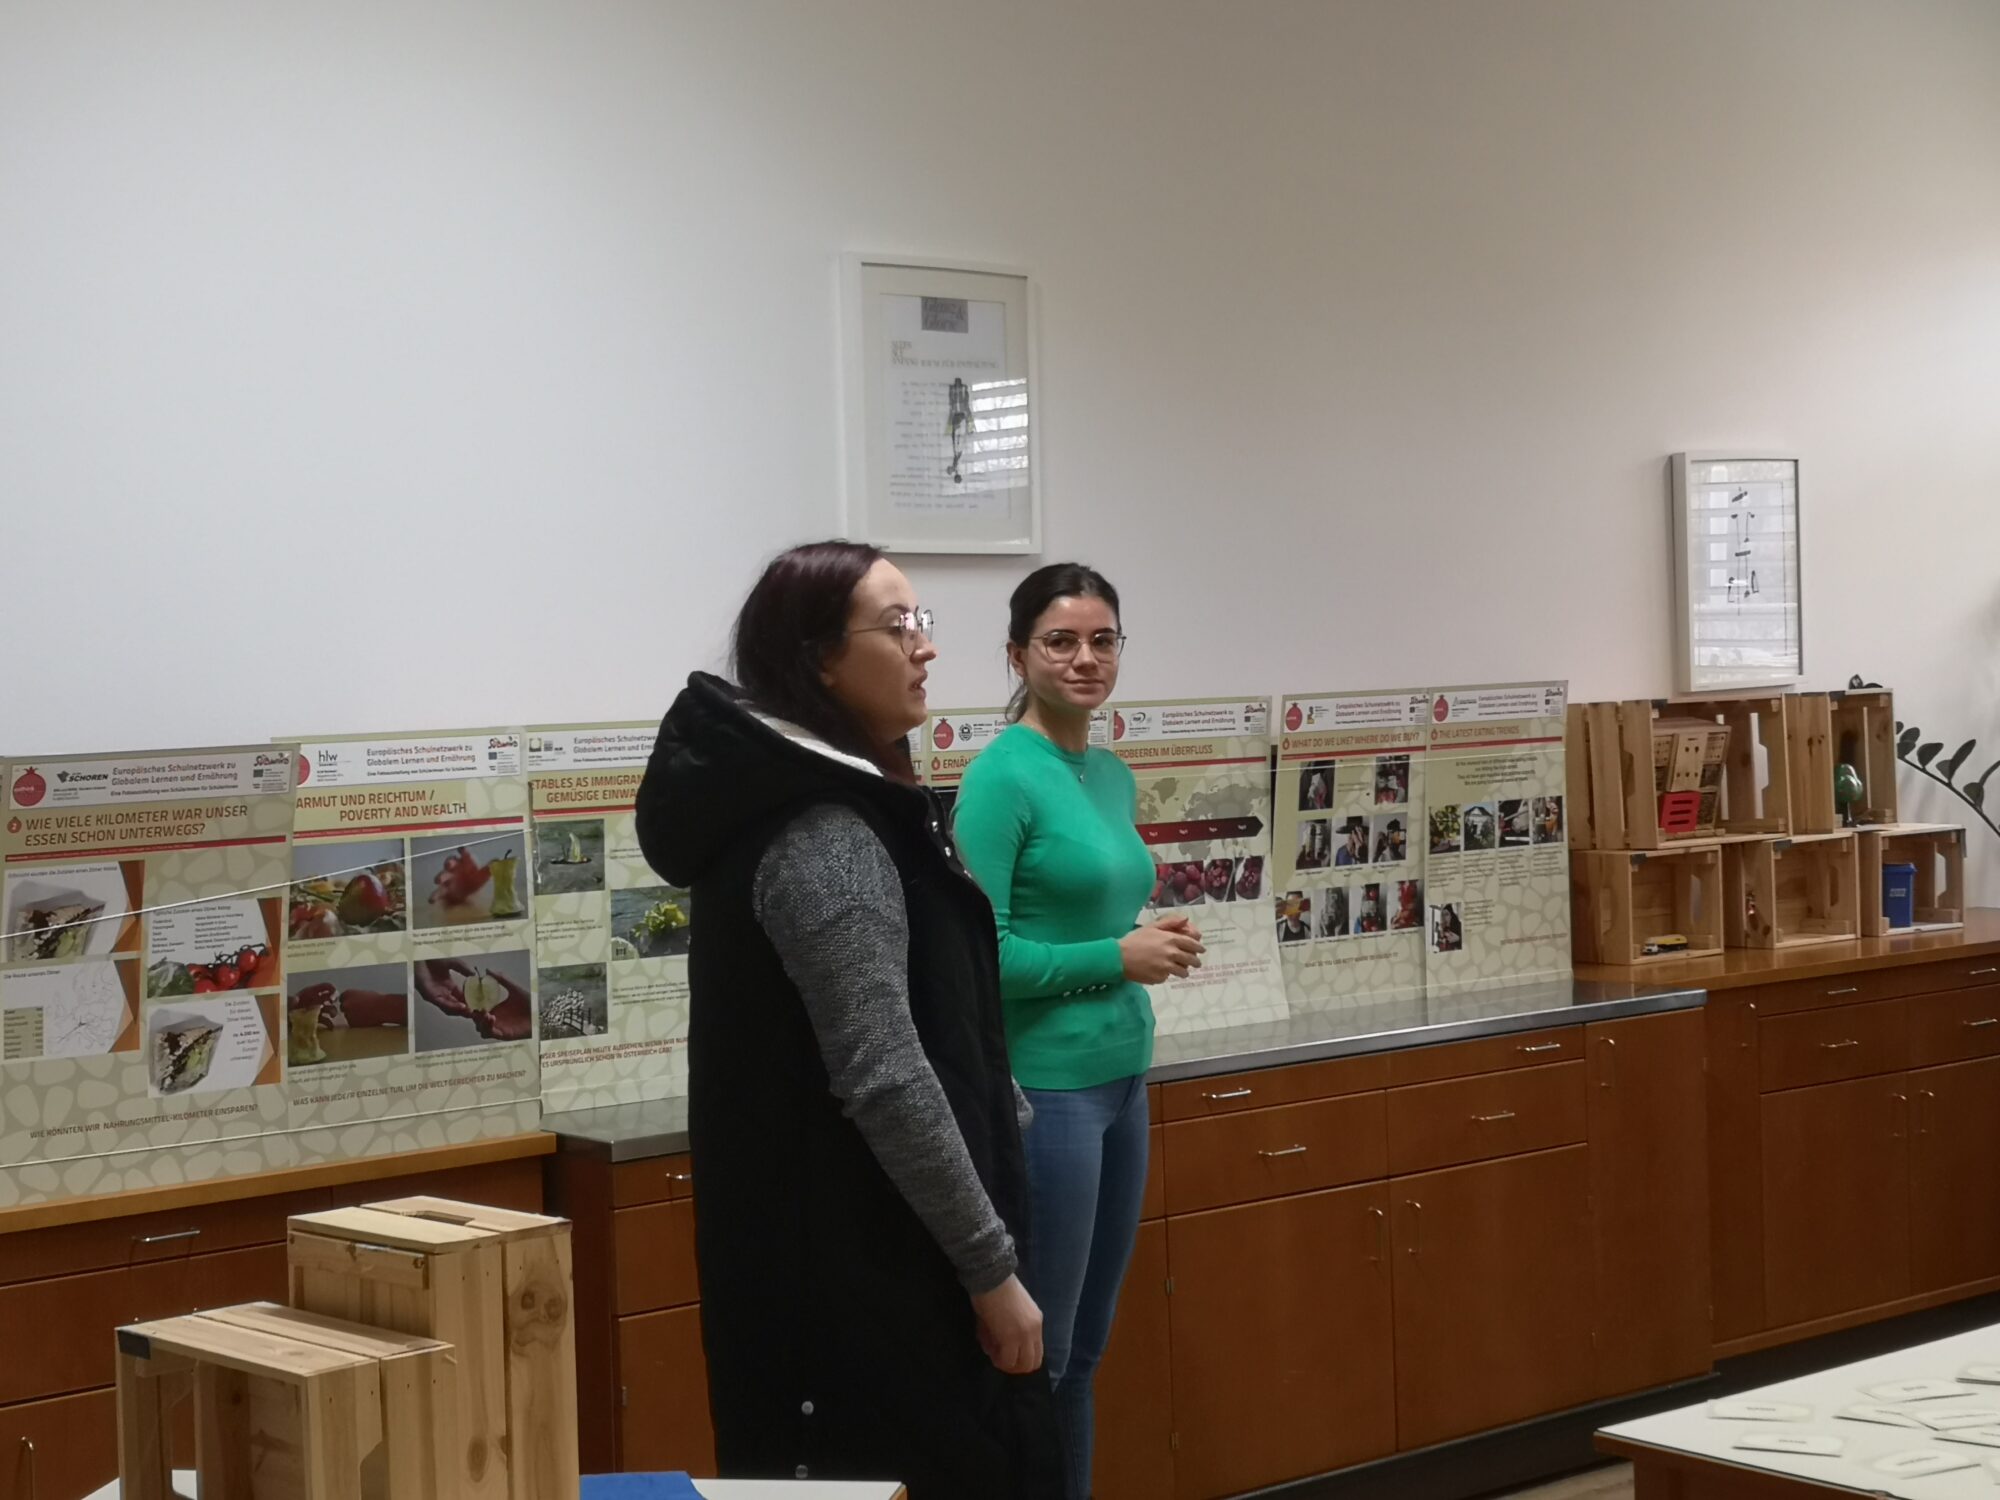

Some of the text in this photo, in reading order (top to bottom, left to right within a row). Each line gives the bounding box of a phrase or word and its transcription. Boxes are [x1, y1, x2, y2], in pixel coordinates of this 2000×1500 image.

[1292, 738, 1312, 749] WHAT
[1313, 738, 1323, 748] DO
[1324, 737, 1335, 747] WE
[1391, 732, 1402, 743] WE
[1403, 731, 1420, 742] BUY?
[318, 749, 338, 763] hlw
[1171, 743, 1213, 756] ÜBERFLUSS
[112, 764, 166, 778] Europäisches
[167, 761, 226, 774] Schulnetzwerk
[401, 756, 425, 766] Lernen
[68, 773, 109, 783] SCHOREN
[111, 770, 239, 787] Globalem Lernen und Ernährung
[576, 776, 590, 788] AS
[296, 795, 337, 809] ARMUT
[340, 794, 366, 807] UND
[369, 790, 426, 805] REICHTUM
[546, 788, 600, 804] GEMÜSIGE
[26, 804, 249, 832] WIE VIELE KILOMETER WAR UNSER
[340, 802, 467, 822] POVERTY AND WEALTH
[25, 822, 206, 847] ESSEN SCHON UNTERWEGS?
[30, 1128, 45, 1140] WIE
[46, 1124, 84, 1138] KÖNNTEN
[84, 1122, 101, 1132] WIR
